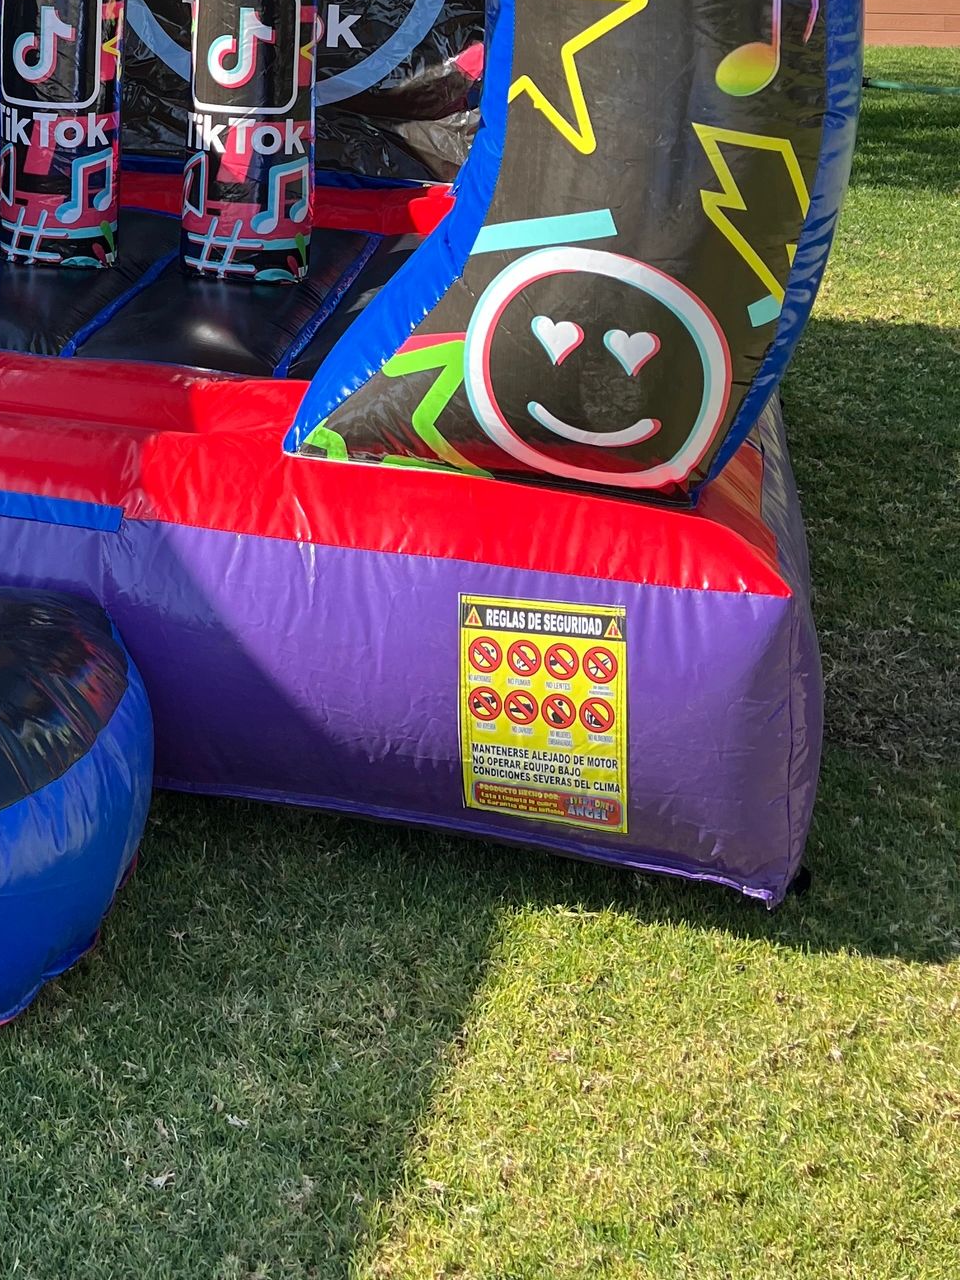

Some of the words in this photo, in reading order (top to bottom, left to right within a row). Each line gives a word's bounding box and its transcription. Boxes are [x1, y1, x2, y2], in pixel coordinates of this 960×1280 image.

[486, 608, 525, 629] REGLAS
[528, 612, 541, 630] DE
[544, 614, 603, 636] SEGURIDAD
[472, 743, 529, 759] MANTENERSE
[532, 751, 571, 764] ALEJADO
[573, 755, 584, 766] DE
[587, 757, 618, 769] MOTOR
[472, 755, 485, 765] NO
[487, 757, 521, 770] OPERAR
[524, 761, 556, 774] EQUIPO
[558, 766, 581, 777] BAJO
[473, 766, 531, 782] CONDICIONES
[533, 773, 572, 787] SEVERAS
[574, 779, 591, 789] DEL
[593, 781, 621, 793] CLIMA
[479, 783, 517, 795] PRODUCTO
[518, 789, 543, 799] HECHO
[568, 804, 609, 821] ANGEL
